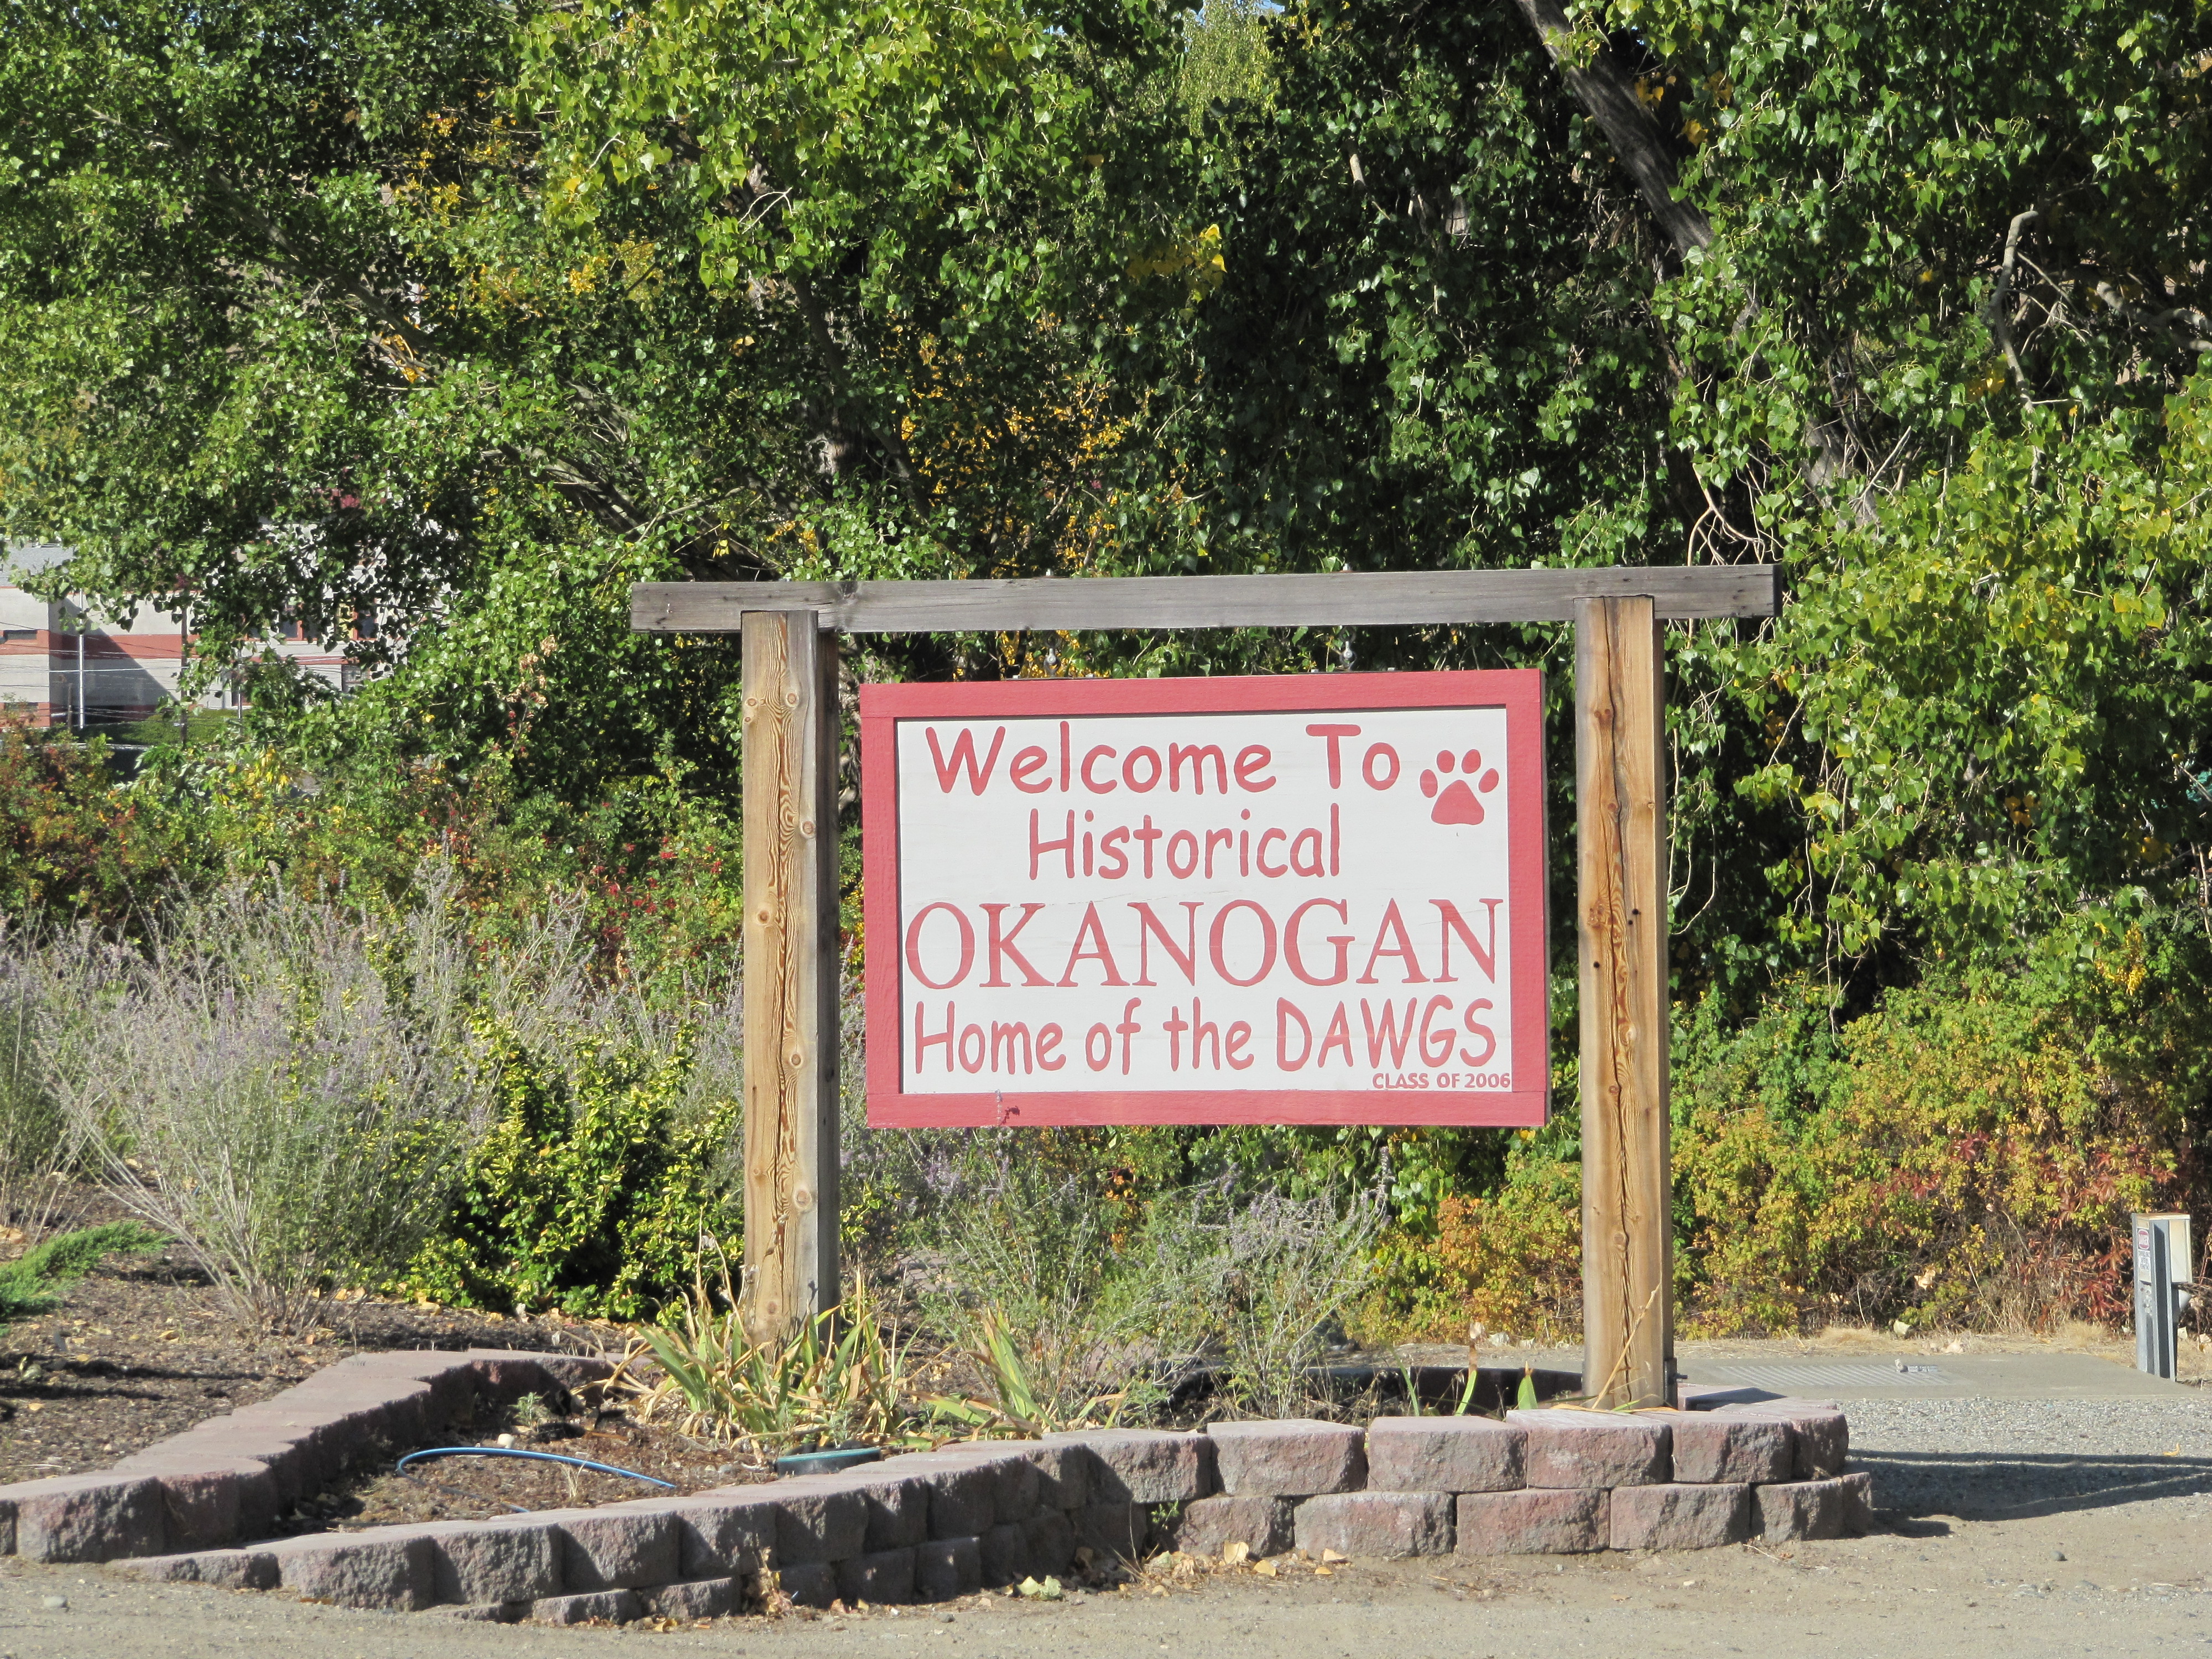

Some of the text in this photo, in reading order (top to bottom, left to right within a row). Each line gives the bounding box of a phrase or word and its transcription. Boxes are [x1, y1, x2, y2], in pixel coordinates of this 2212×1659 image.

[926, 720, 1401, 796] Welcome To
[1029, 802, 1340, 880] Historical
[905, 898, 1504, 989] OKANOGAN
[915, 995, 1496, 1074] Home of the DAWGS
[1372, 1073, 1511, 1089] CLASS OF 2006
